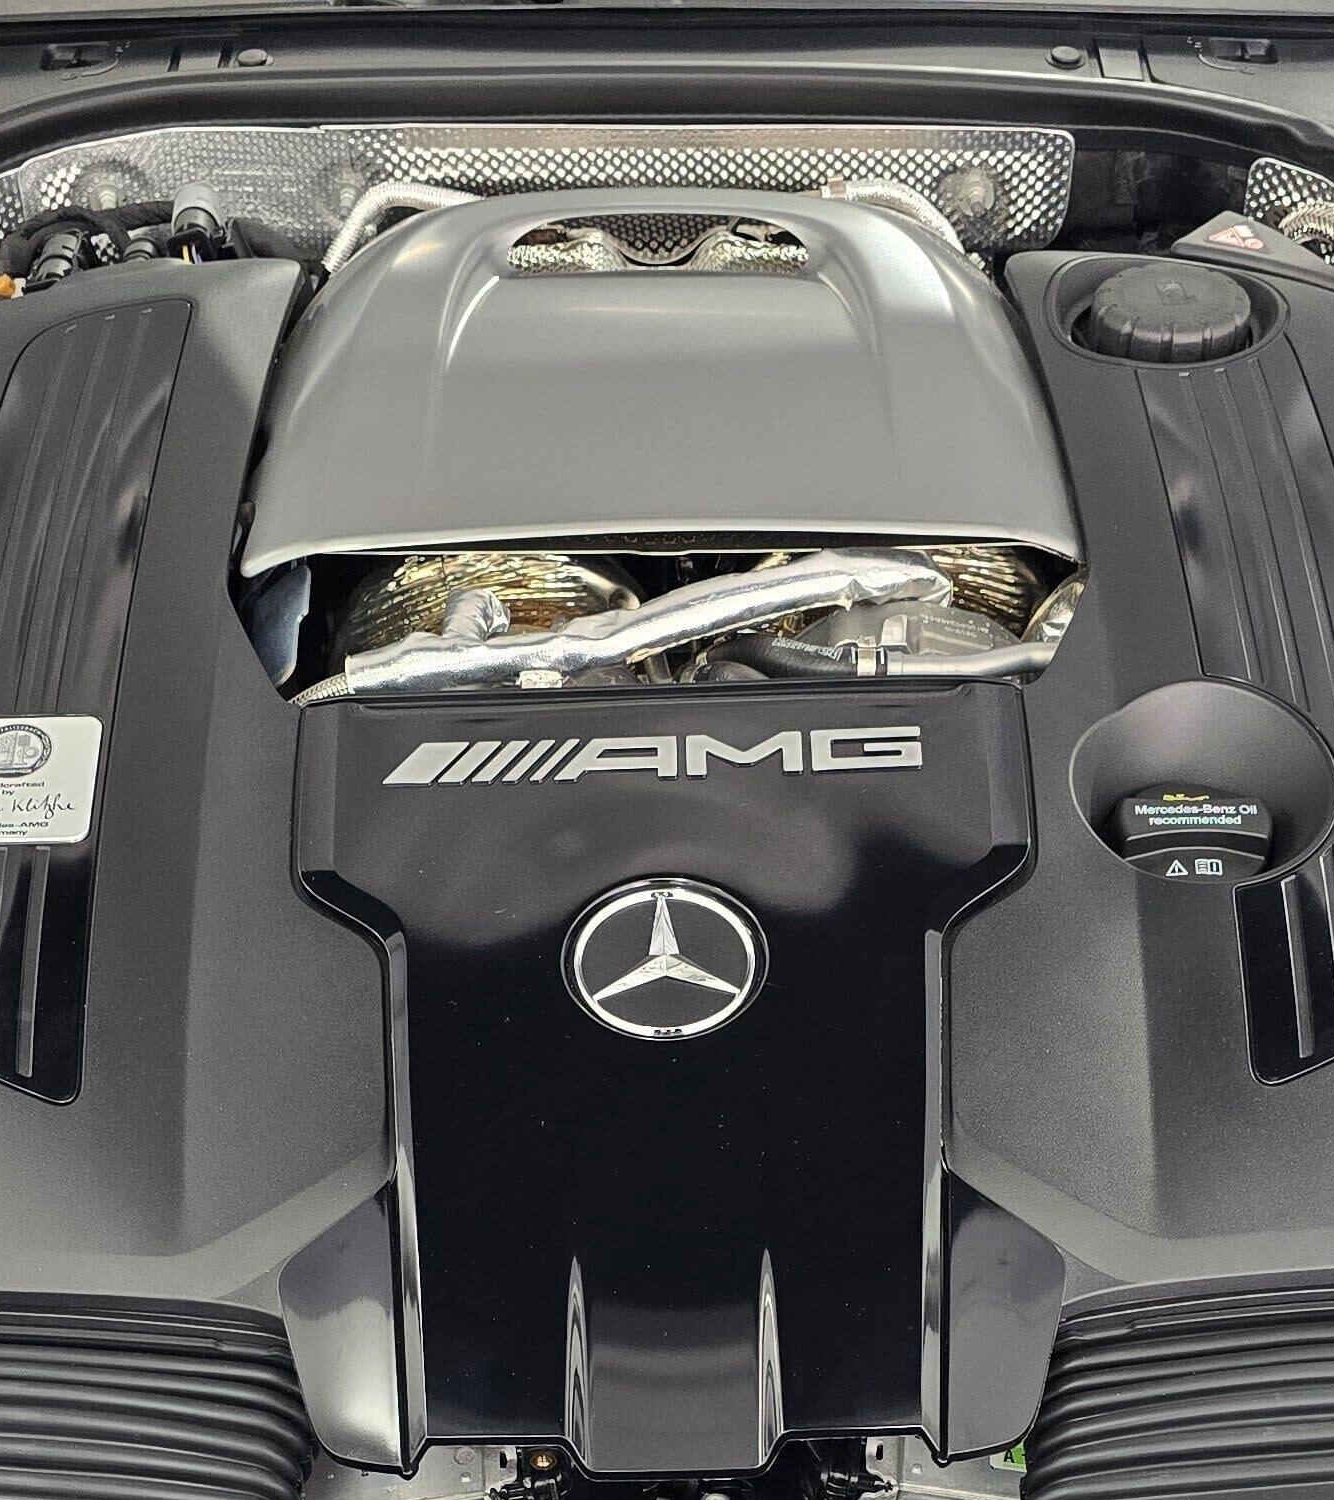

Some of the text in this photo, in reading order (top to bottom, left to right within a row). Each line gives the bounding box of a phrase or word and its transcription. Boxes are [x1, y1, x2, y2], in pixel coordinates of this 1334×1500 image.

[553, 725, 923, 783] AMG
[1134, 803, 1258, 815] Mercedes-Benz Oil
[1148, 814, 1242, 826] recommended
